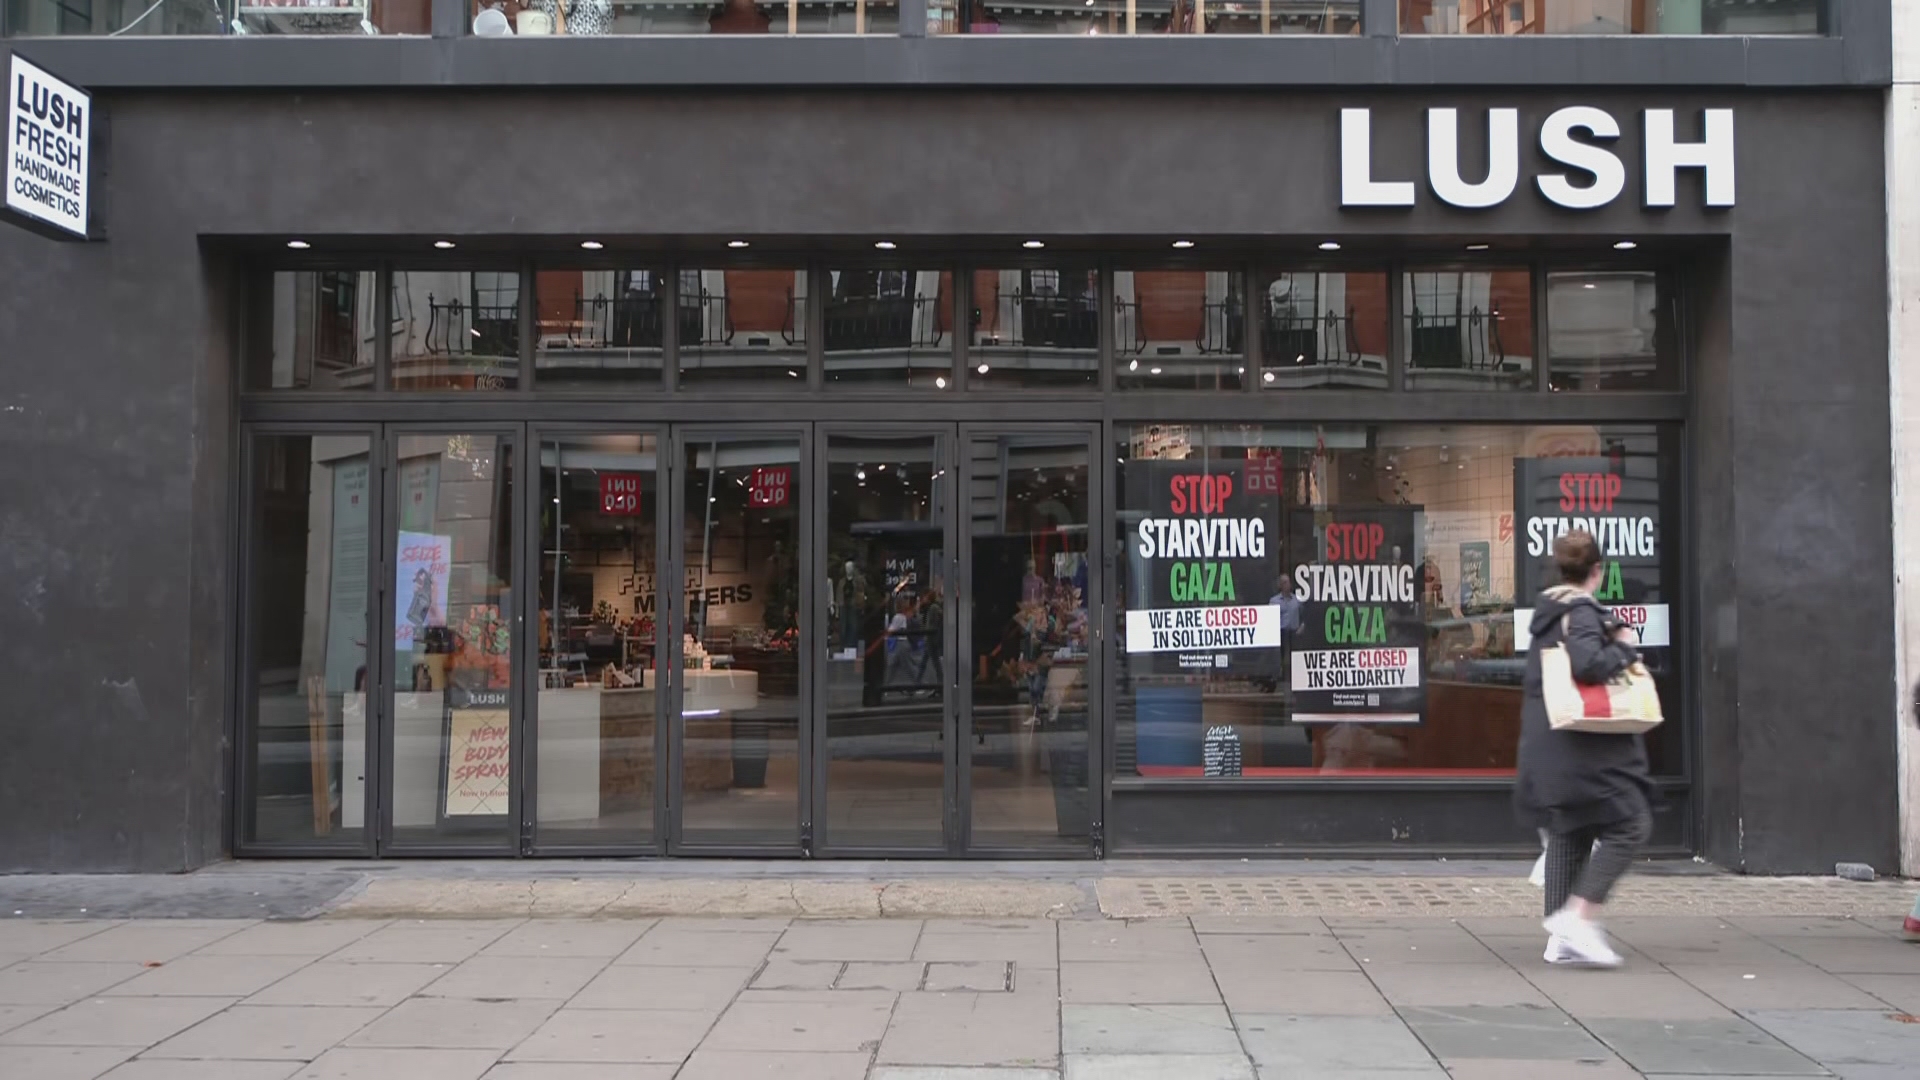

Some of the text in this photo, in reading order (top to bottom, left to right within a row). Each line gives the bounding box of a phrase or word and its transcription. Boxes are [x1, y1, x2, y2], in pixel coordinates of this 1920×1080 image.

[17, 73, 82, 140] LUSH
[16, 114, 81, 174] FRESH
[1340, 105, 1736, 209] LUSH
[15, 151, 80, 196] HANDMADE
[14, 176, 80, 218] COSMETICS
[1170, 474, 1233, 514] STOP
[1559, 472, 1621, 512] STOP
[399, 544, 441, 563] SEIZE
[1138, 518, 1265, 558] STARVING
[1326, 523, 1384, 561] STOP
[1527, 516, 1654, 557] STAVING
[618, 567, 702, 595] FRH
[634, 583, 753, 614] MTERS
[1169, 561, 1235, 602] GAZA
[1294, 564, 1415, 603] STARVING
[1148, 607, 1258, 630] WE ARE CLOSED
[1324, 606, 1387, 644] GAZA
[1611, 606, 1647, 625] OSED
[1152, 627, 1256, 649] IN SOLIDARITY
[1304, 649, 1408, 670] WE ARE CLOSED
[1307, 666, 1406, 688] IN SOLIDARITY
[470, 694, 506, 704] LUSH
[464, 744, 509, 762] BODY
[469, 726, 508, 743] NEW
[454, 763, 509, 781] SPRAY
